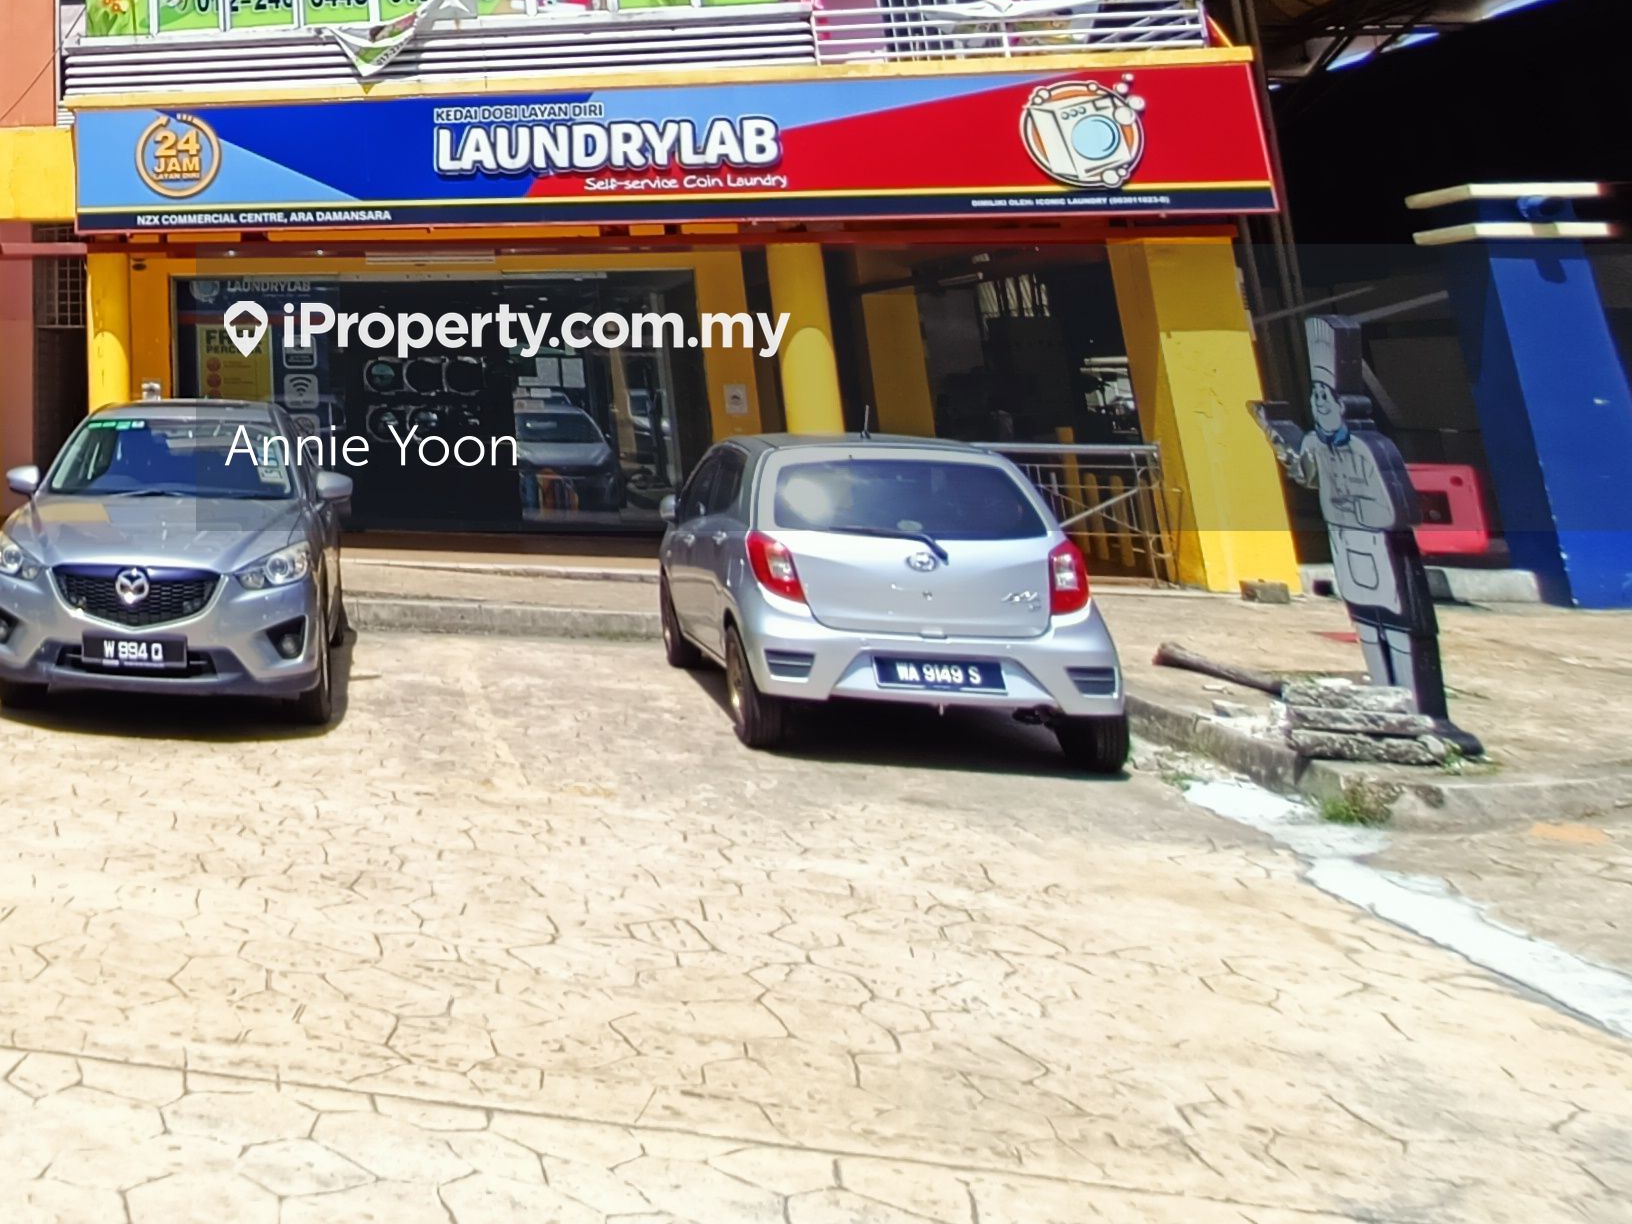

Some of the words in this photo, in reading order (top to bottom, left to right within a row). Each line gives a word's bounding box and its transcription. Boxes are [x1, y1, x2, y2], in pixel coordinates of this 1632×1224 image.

[434, 107, 478, 122] KEDAI
[480, 105, 519, 121] DOBI
[521, 104, 567, 119] LAYAN
[570, 103, 604, 118] DIRI
[154, 129, 201, 156] 24
[435, 117, 781, 173] LAUNDRYLAB
[153, 156, 201, 173] JAM
[584, 177, 679, 191] Self-service
[684, 175, 724, 189] Coin
[726, 174, 788, 188] Laundry
[137, 215, 160, 225] NZX
[161, 214, 237, 225] COMMERCIAL
[239, 212, 288, 224] CENTRE,
[289, 212, 314, 222] ARA
[315, 210, 392, 222] DAMANSARA
[227, 279, 311, 292] LAUNDRYLAB
[103, 640, 115, 658] W
[895, 662, 921, 681] WA
[968, 665, 982, 685] S
